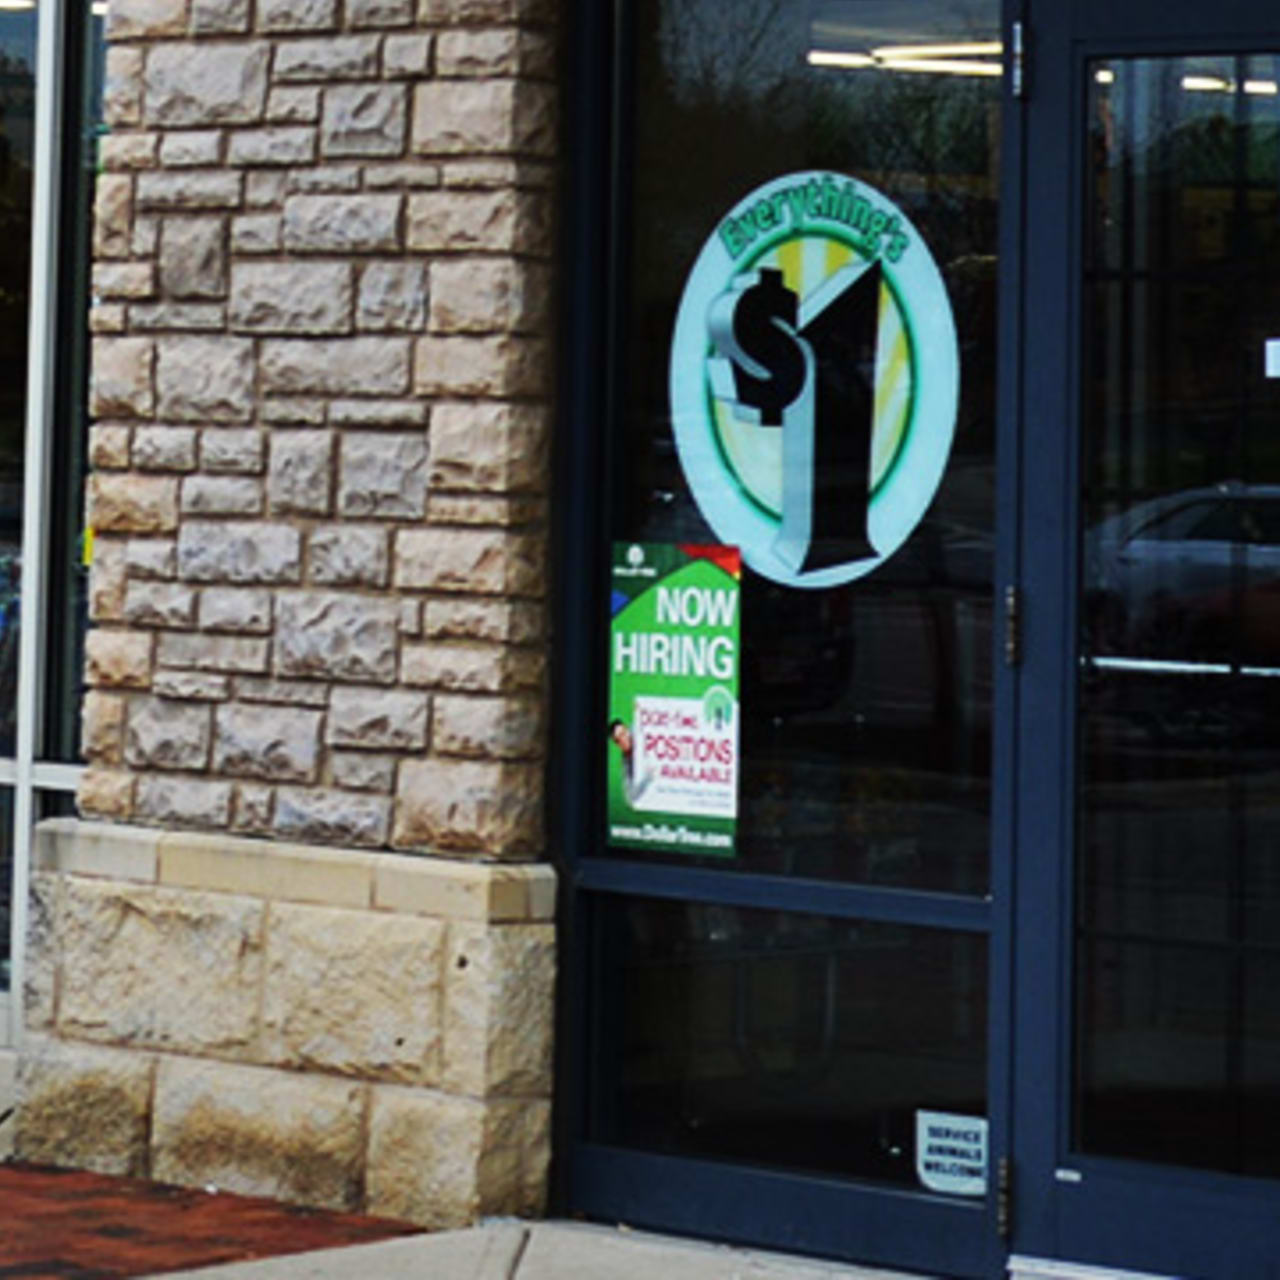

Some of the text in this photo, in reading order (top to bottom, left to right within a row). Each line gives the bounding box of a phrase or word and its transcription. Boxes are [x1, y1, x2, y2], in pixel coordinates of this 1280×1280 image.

[719, 173, 911, 264] Everything's
[656, 586, 738, 628] NOW
[615, 632, 734, 680] HIRING
[643, 734, 733, 767] POSITIONS
